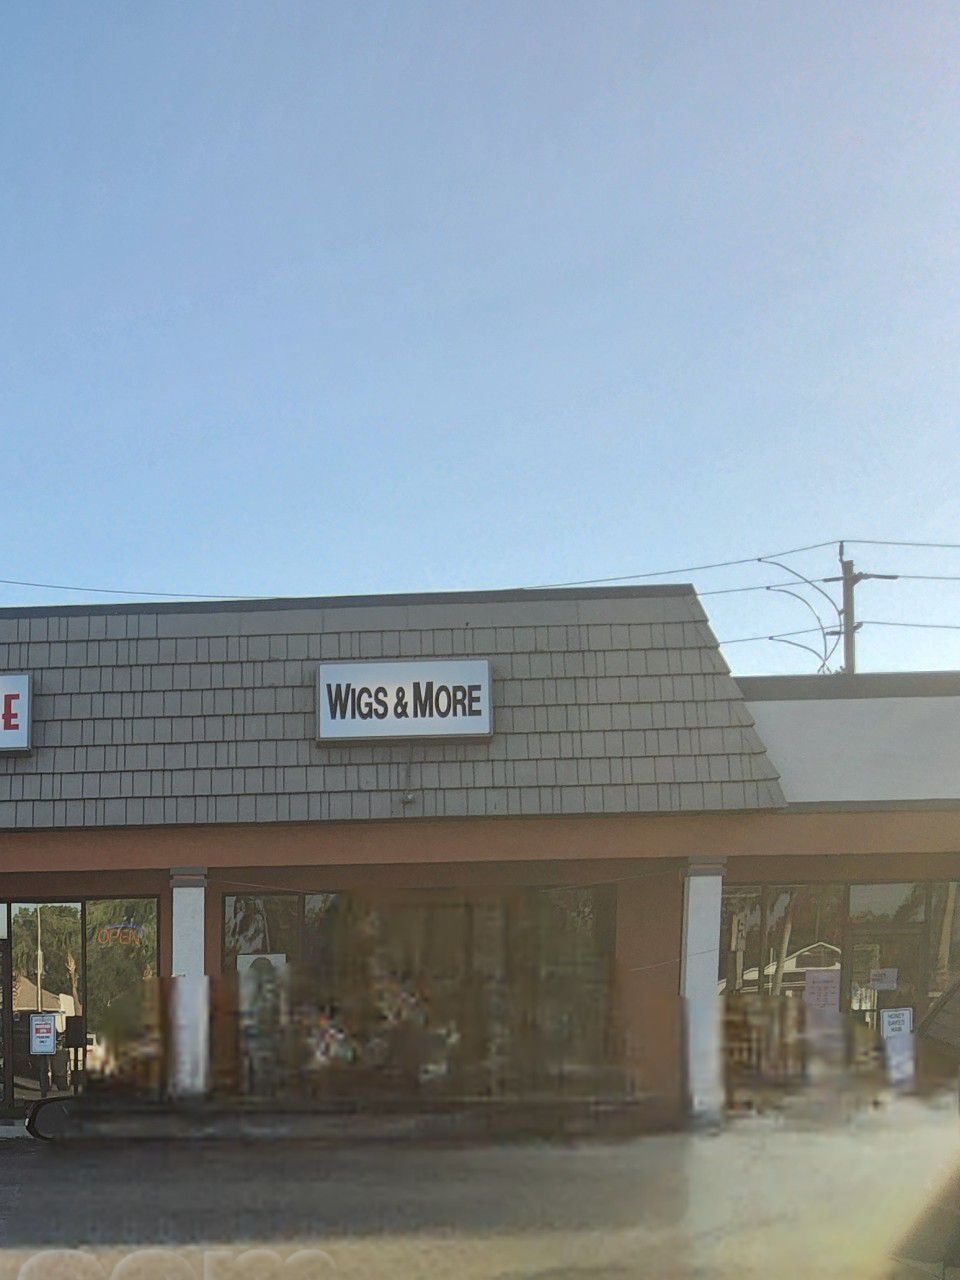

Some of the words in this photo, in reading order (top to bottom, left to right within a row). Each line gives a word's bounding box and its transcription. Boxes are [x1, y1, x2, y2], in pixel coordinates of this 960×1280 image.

[326, 683, 388, 720] WIGS
[393, 686, 409, 719] &
[413, 681, 482, 718] MORE
[97, 928, 139, 945] OPEN
